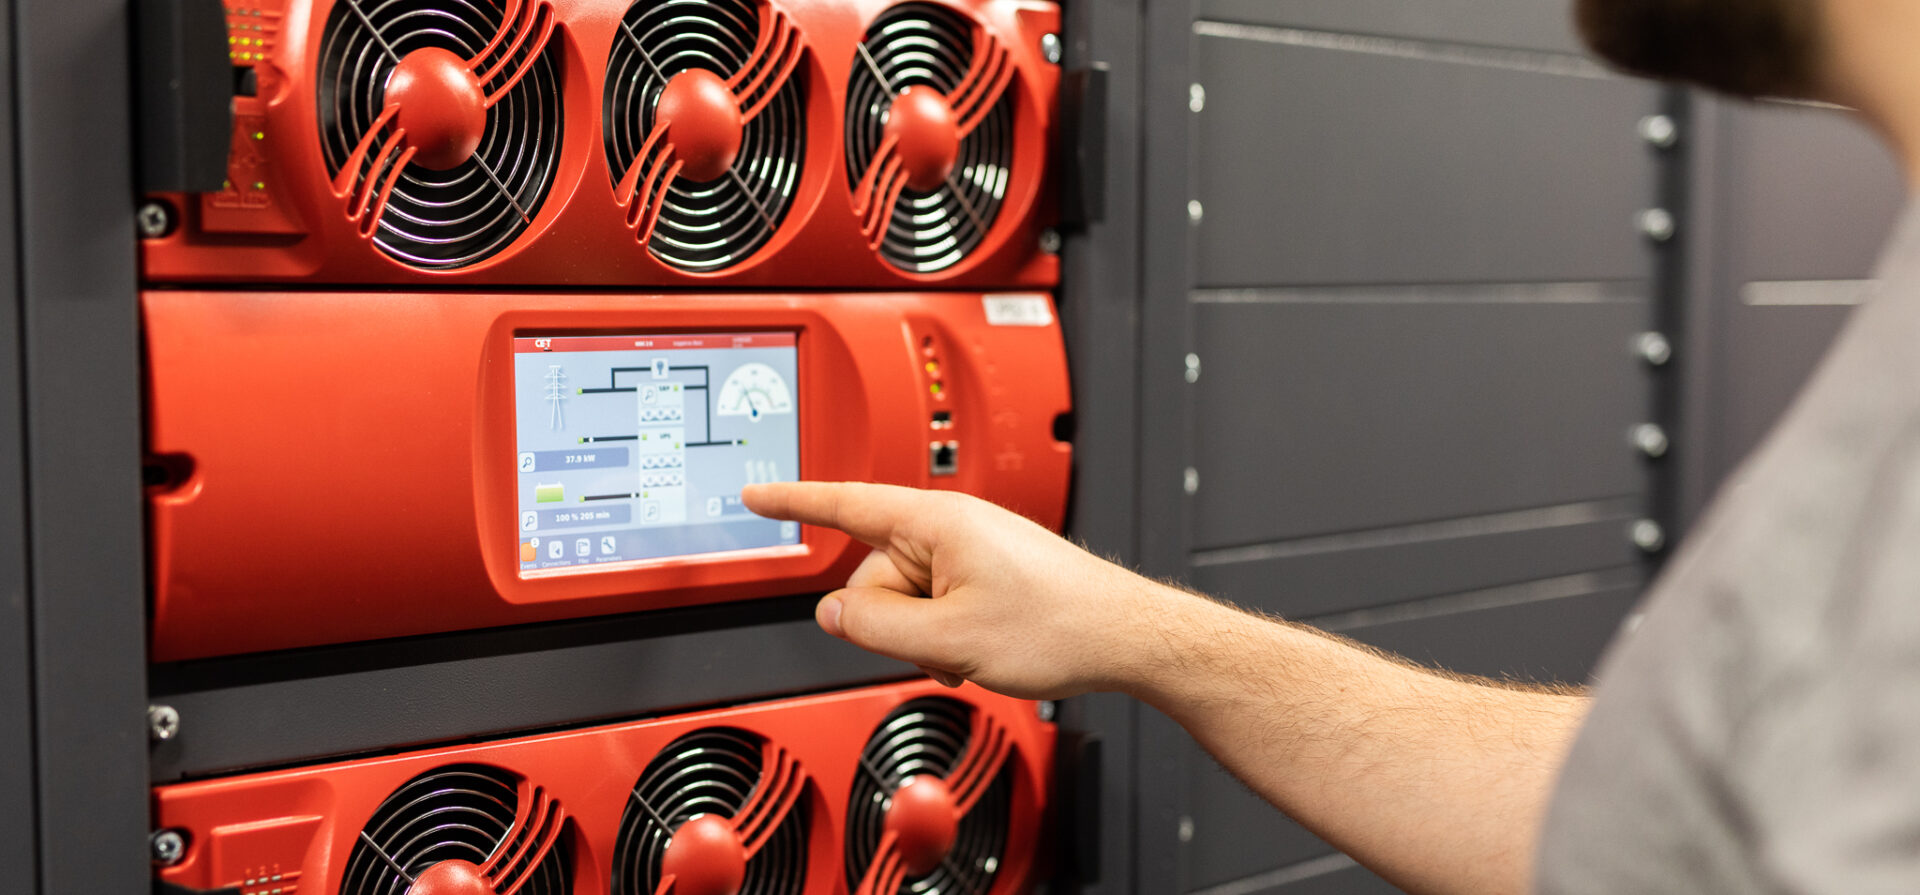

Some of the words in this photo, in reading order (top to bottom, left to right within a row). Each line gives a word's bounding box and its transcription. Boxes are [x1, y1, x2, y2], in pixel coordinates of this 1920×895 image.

[565, 455, 582, 464] 37.9
[583, 454, 596, 463] kW
[555, 514, 570, 523] 100
[571, 513, 579, 521] %
[595, 510, 611, 519] min
